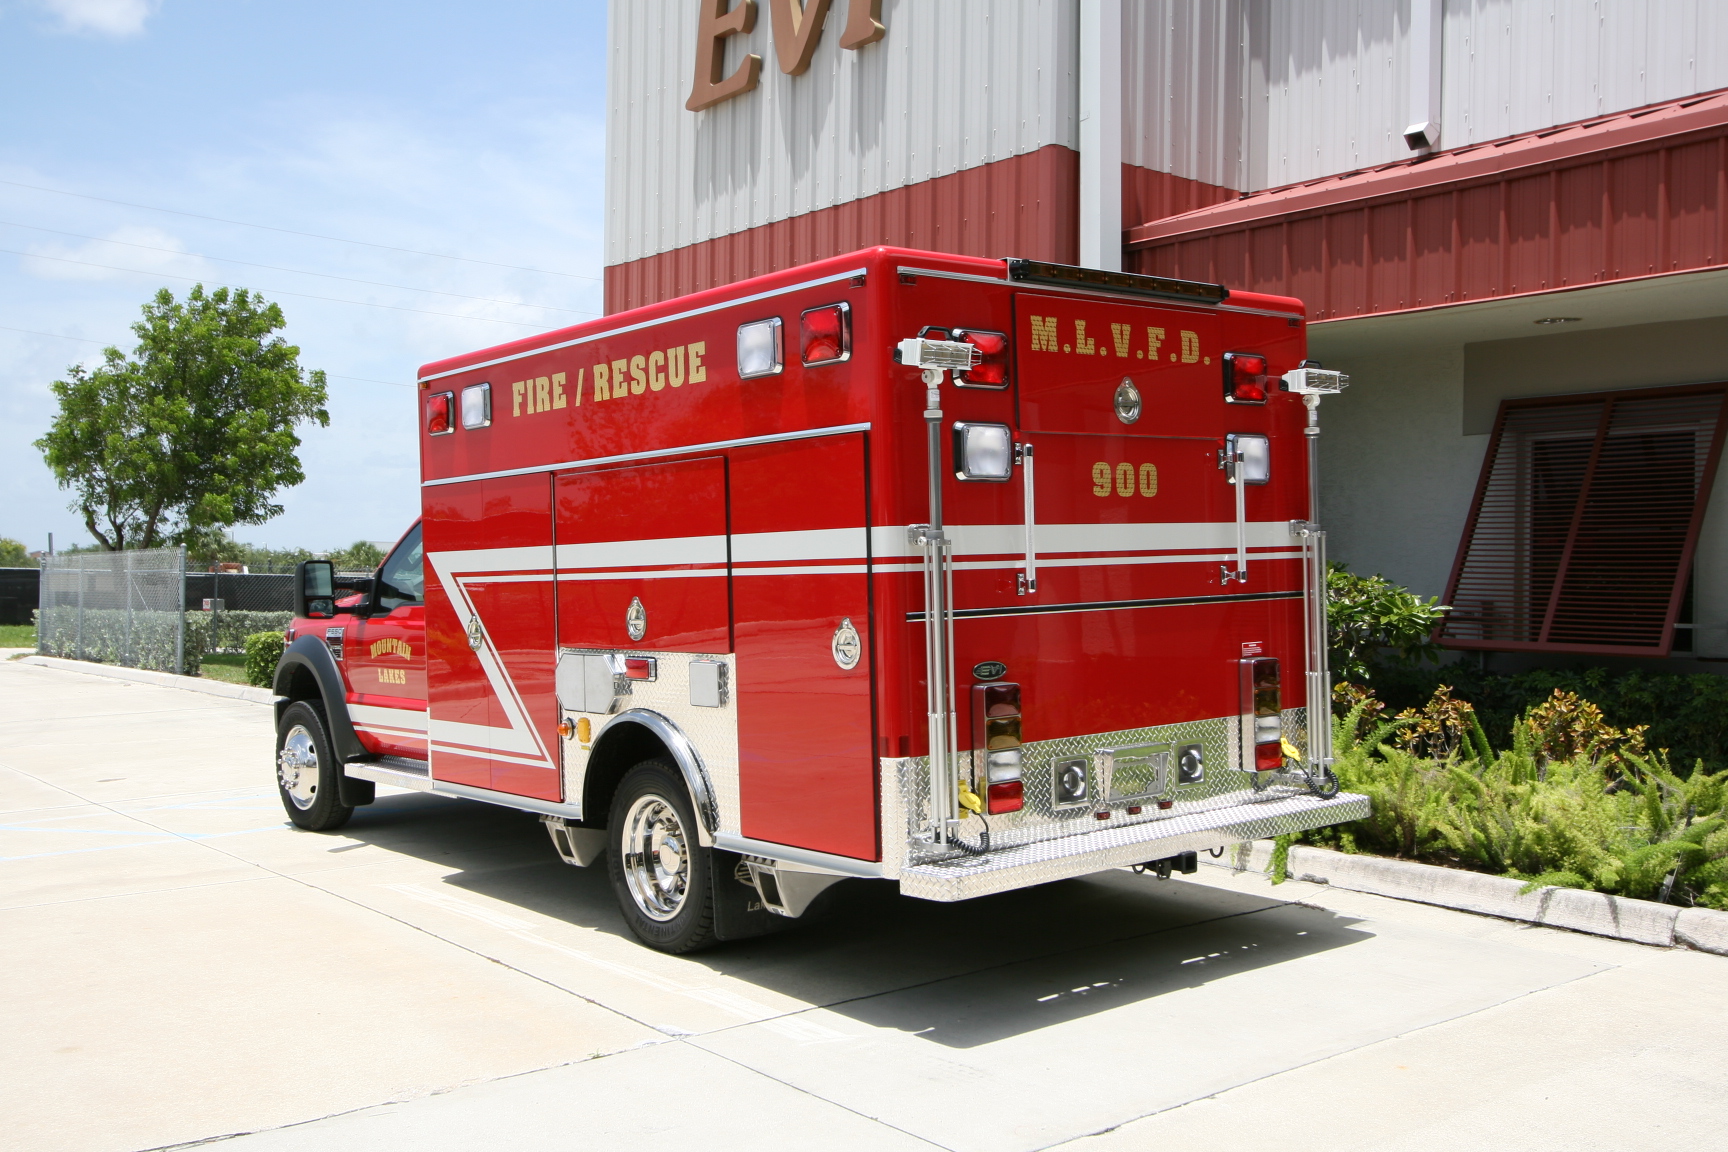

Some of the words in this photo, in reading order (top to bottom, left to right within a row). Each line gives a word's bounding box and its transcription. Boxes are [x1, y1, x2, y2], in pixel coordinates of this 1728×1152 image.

[1030, 315, 1211, 365] M.L.V.F.D.
[512, 371, 567, 418] FIRE
[575, 368, 585, 407] /
[593, 341, 707, 402] RESCUE
[1092, 461, 1158, 497] 900
[370, 638, 411, 661] MOUNTAIN
[378, 667, 405, 684] LAKES
